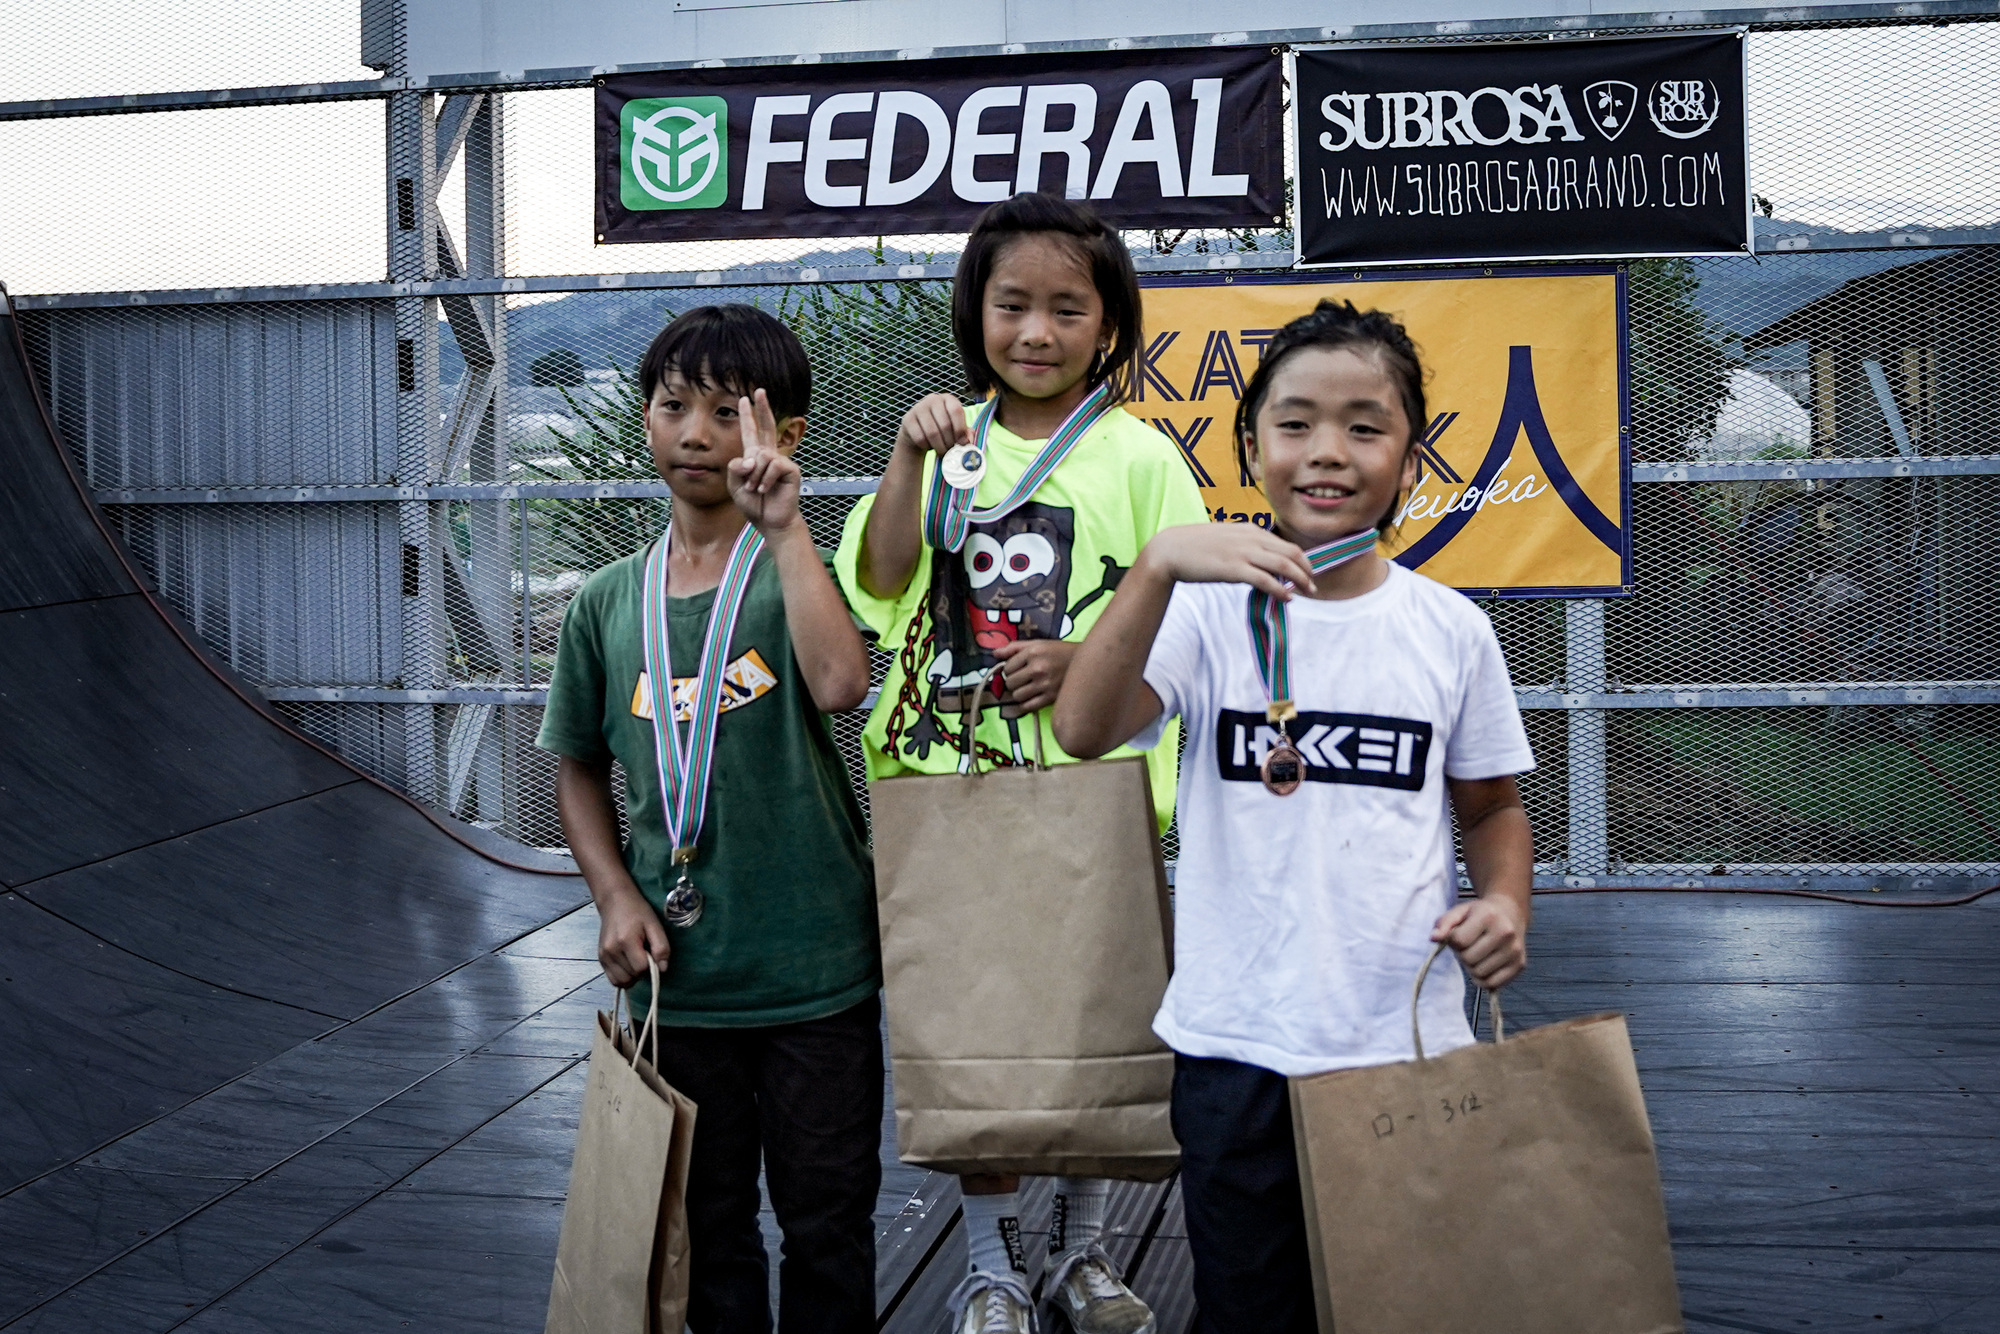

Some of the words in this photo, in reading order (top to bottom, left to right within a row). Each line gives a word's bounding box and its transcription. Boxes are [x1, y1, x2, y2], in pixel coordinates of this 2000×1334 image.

[1319, 83, 1586, 152] SUBROSA
[1659, 80, 1705, 104] SUB
[1659, 101, 1710, 121] ROSA
[741, 78, 1250, 210] FEDERAL
[1320, 152, 1726, 219] WWW.SUBROSABRAND.COM
[1003, 1219, 1027, 1270] STANCE
